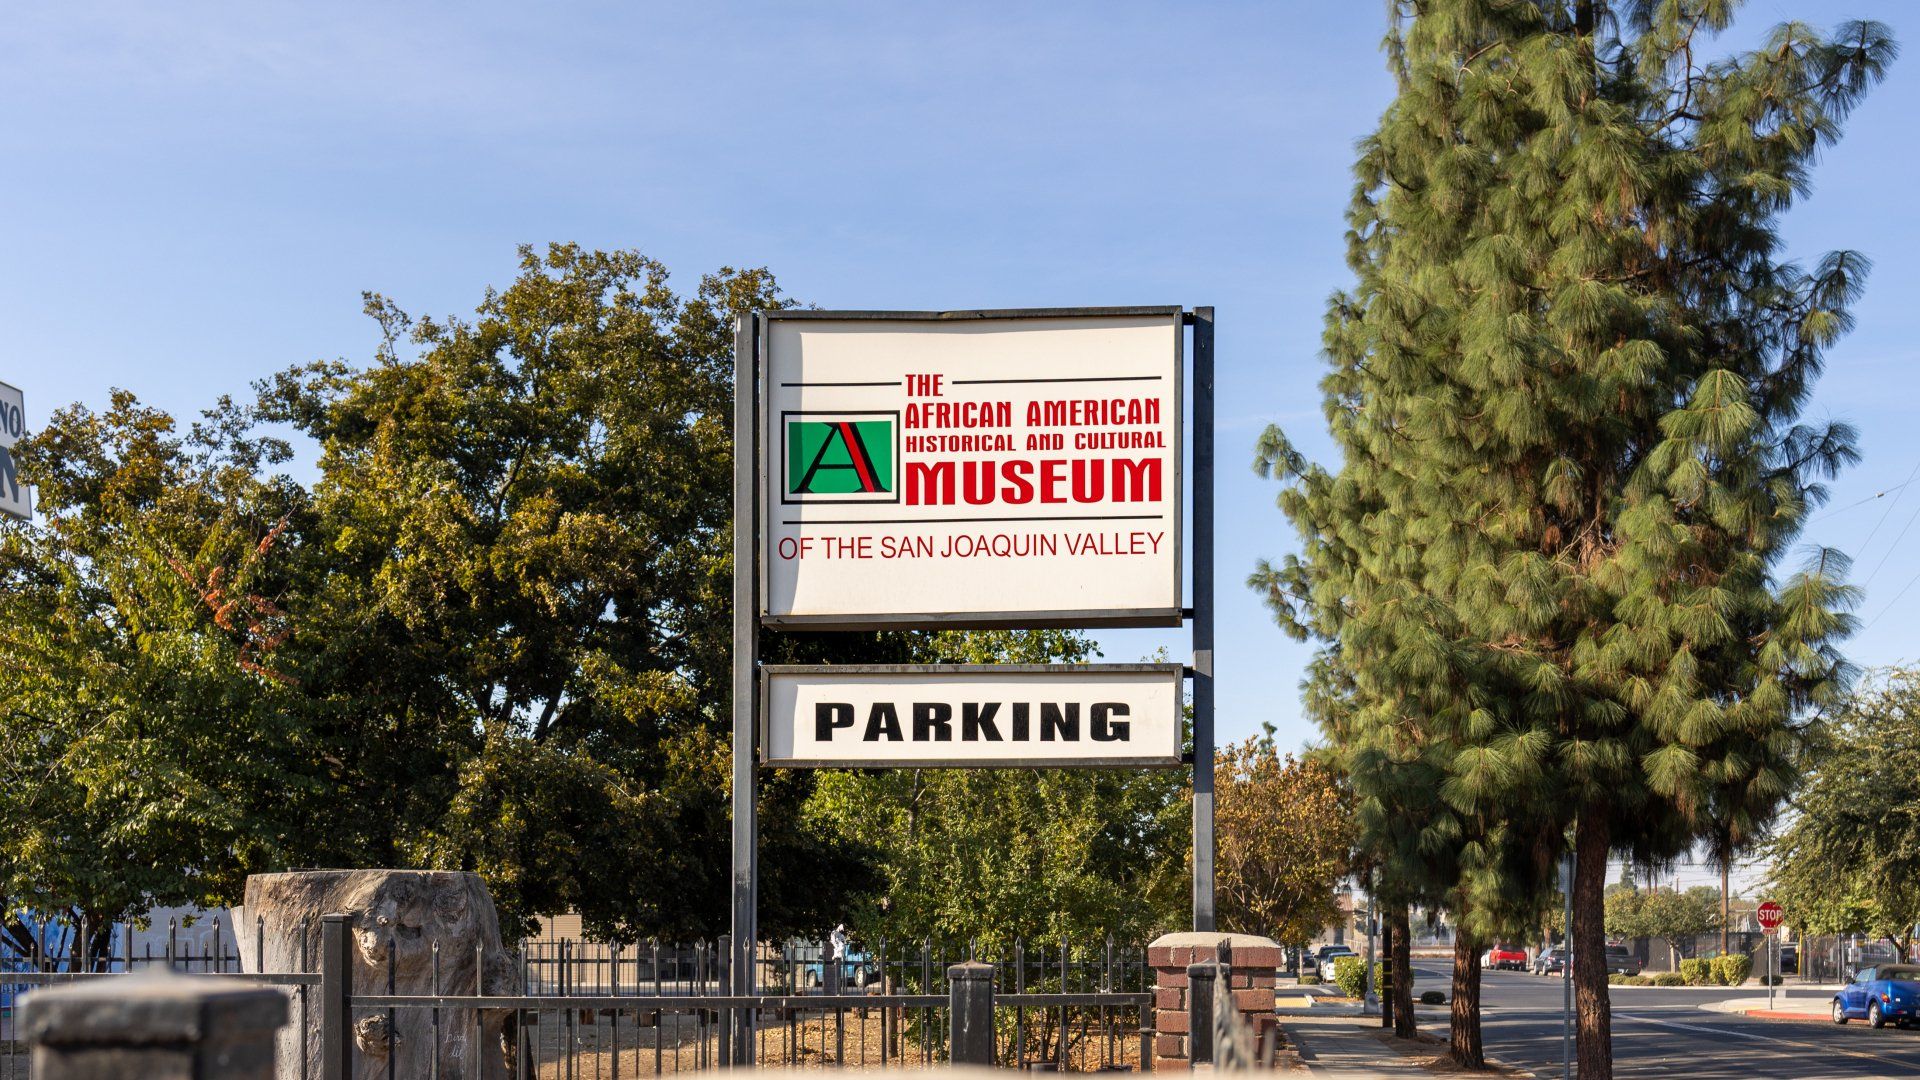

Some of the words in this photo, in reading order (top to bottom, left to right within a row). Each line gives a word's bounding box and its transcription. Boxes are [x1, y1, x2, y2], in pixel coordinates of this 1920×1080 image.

[905, 373, 944, 397] THE
[904, 401, 1012, 429] AFRICAN
[1026, 398, 1161, 427] AMERICAN
[905, 433, 1016, 453] HISTORICAL
[1026, 433, 1064, 451] AND
[1074, 431, 1166, 450] CULTURAL
[905, 458, 1162, 506] MUSEUM
[778, 537, 814, 560] OF
[821, 536, 874, 559] THE
[880, 535, 933, 558] SAN
[940, 534, 1057, 558] JOAQUIN
[1064, 532, 1165, 556] VALLEY
[815, 702, 1131, 742] PARKING
[1758, 909, 1782, 920] STOP
